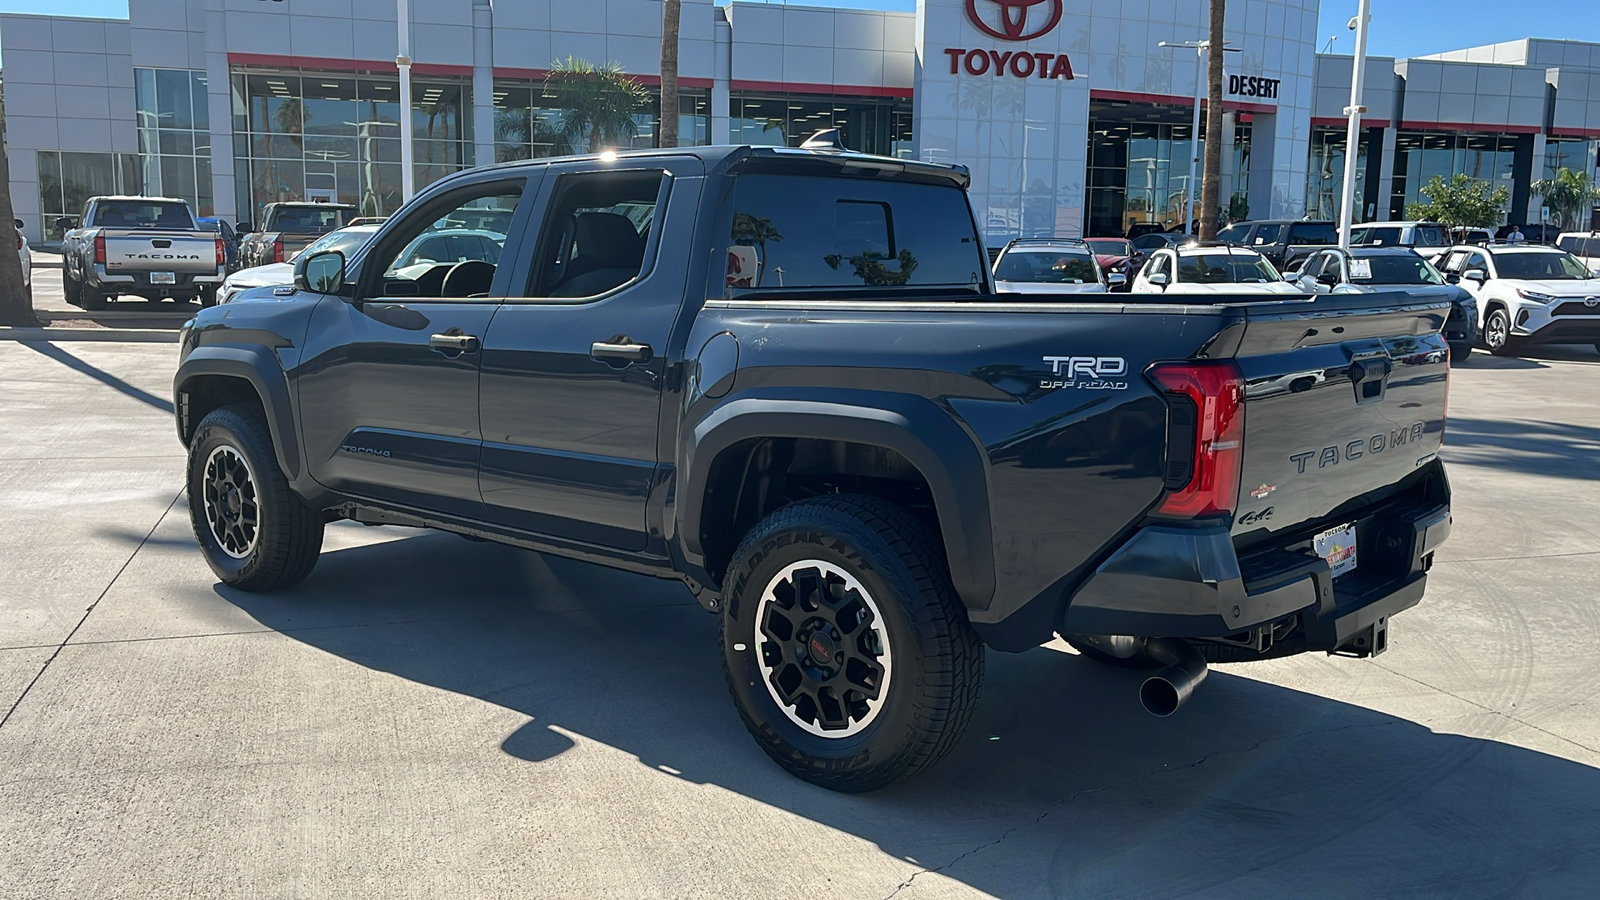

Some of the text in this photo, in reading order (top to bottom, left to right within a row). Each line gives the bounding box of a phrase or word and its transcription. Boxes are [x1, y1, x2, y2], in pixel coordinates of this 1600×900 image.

[944, 48, 1074, 80] TOYOTA
[1229, 75, 1280, 98] DESERT
[1043, 356, 1127, 379] TRD
[1040, 380, 1128, 390] OFF ROAD
[342, 445, 392, 458] TACOMA
[1290, 421, 1425, 473] TACOMA
[1324, 525, 1346, 537] TUCSON
[728, 531, 874, 622] WILDPEAK A/T
